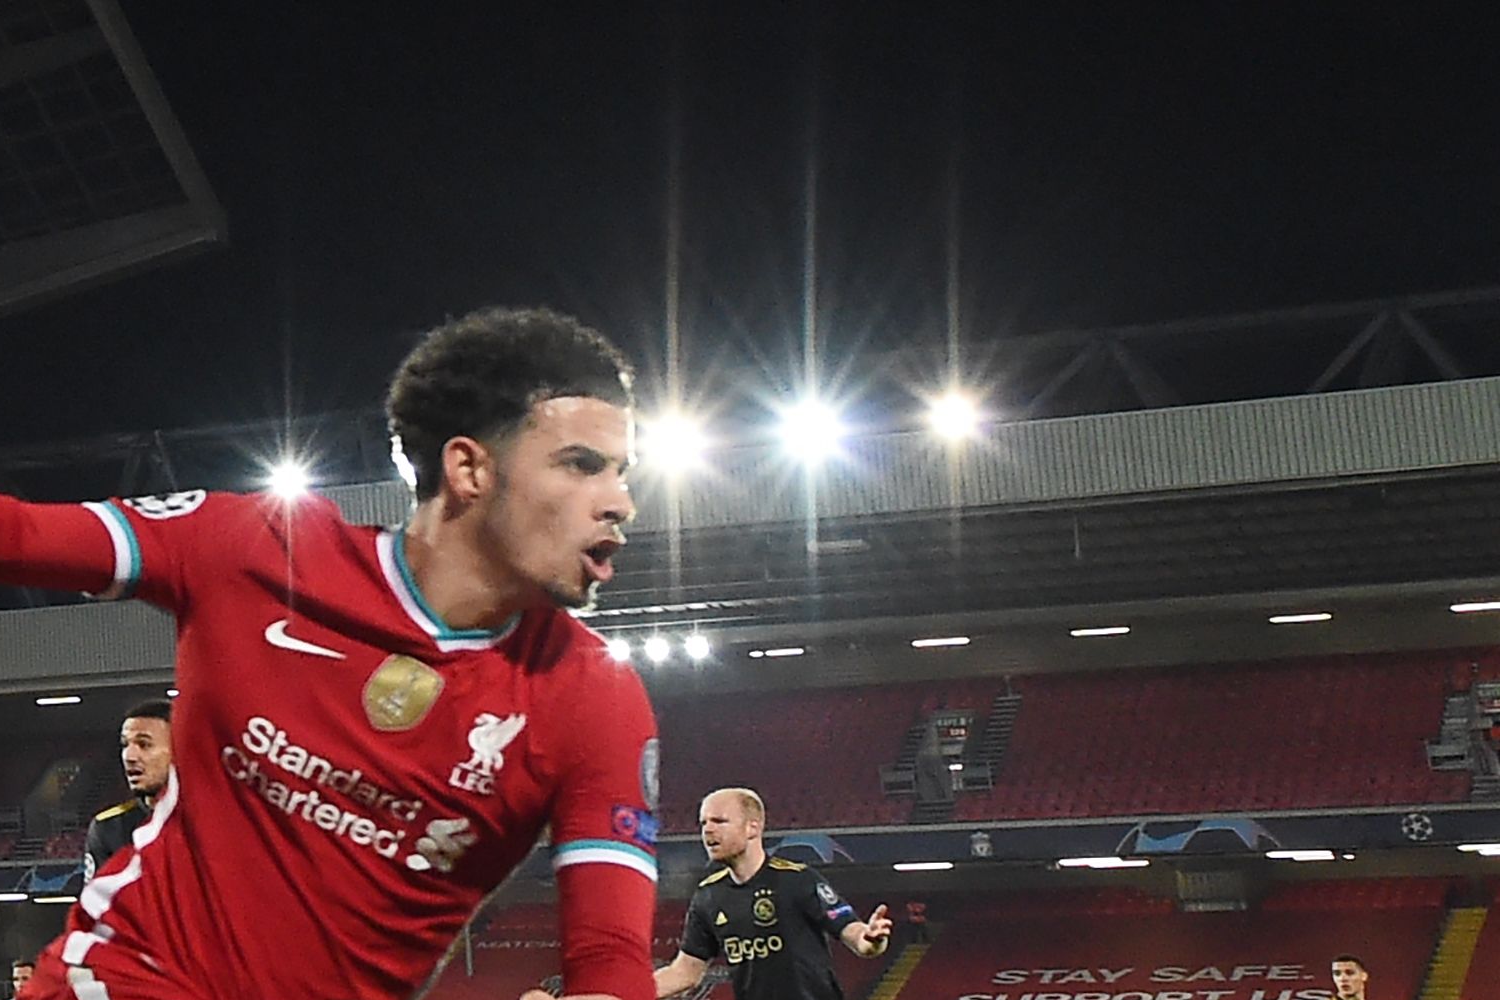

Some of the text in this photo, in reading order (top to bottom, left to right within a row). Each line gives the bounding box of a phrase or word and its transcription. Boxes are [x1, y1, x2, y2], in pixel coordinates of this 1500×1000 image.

[222, 746, 405, 858] Chartered
[242, 717, 422, 821] Standard
[992, 965, 1315, 985] STAY SAFE.
